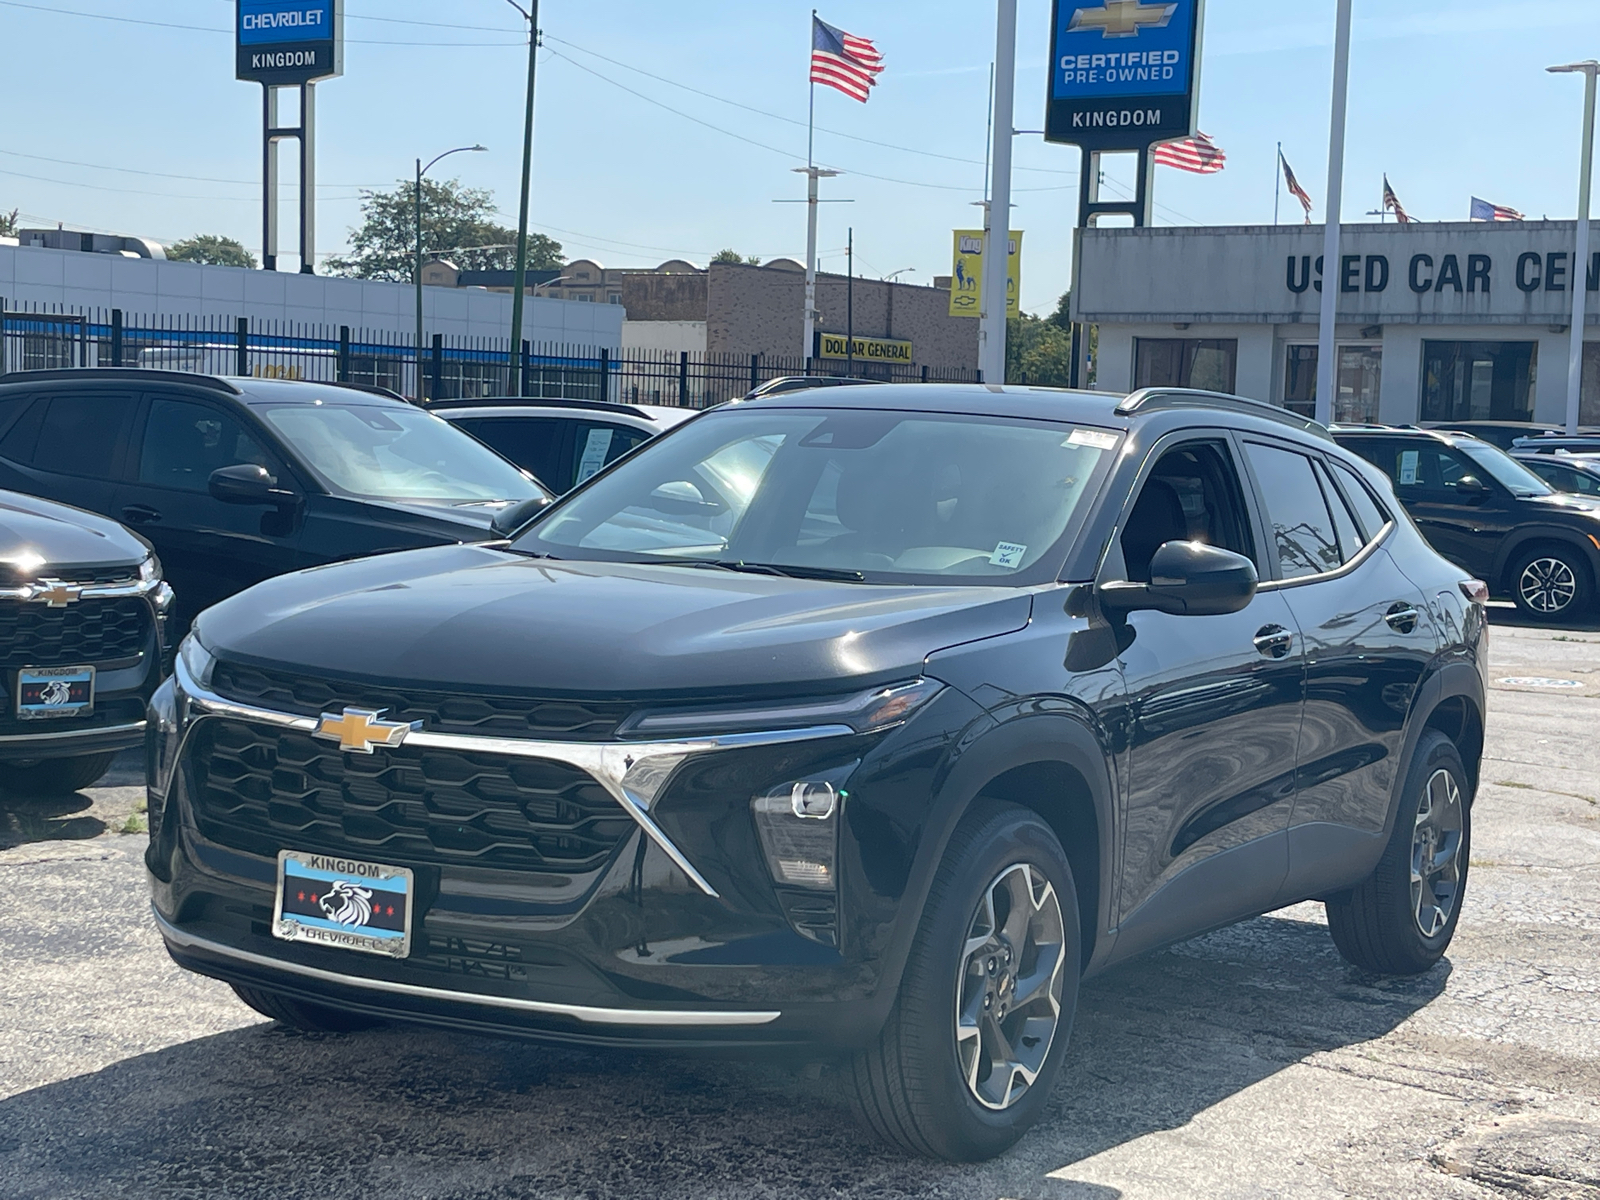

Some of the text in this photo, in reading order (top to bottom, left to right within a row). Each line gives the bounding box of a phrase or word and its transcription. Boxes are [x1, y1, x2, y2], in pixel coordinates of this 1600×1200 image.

[243, 9, 323, 30] CHEVROLET
[252, 51, 315, 68] KINGDOM
[1060, 50, 1179, 69] CERTIFIED
[1064, 66, 1173, 84] PRE-OWNED
[1072, 109, 1160, 127] KINGDOM
[1408, 253, 1492, 293] CAR
[825, 339, 909, 359] DOLLAR GENERAL
[998, 544, 1024, 552] SAFETY
[38, 668, 77, 676] KINGDOM
[311, 855, 380, 878] KINGDOM
